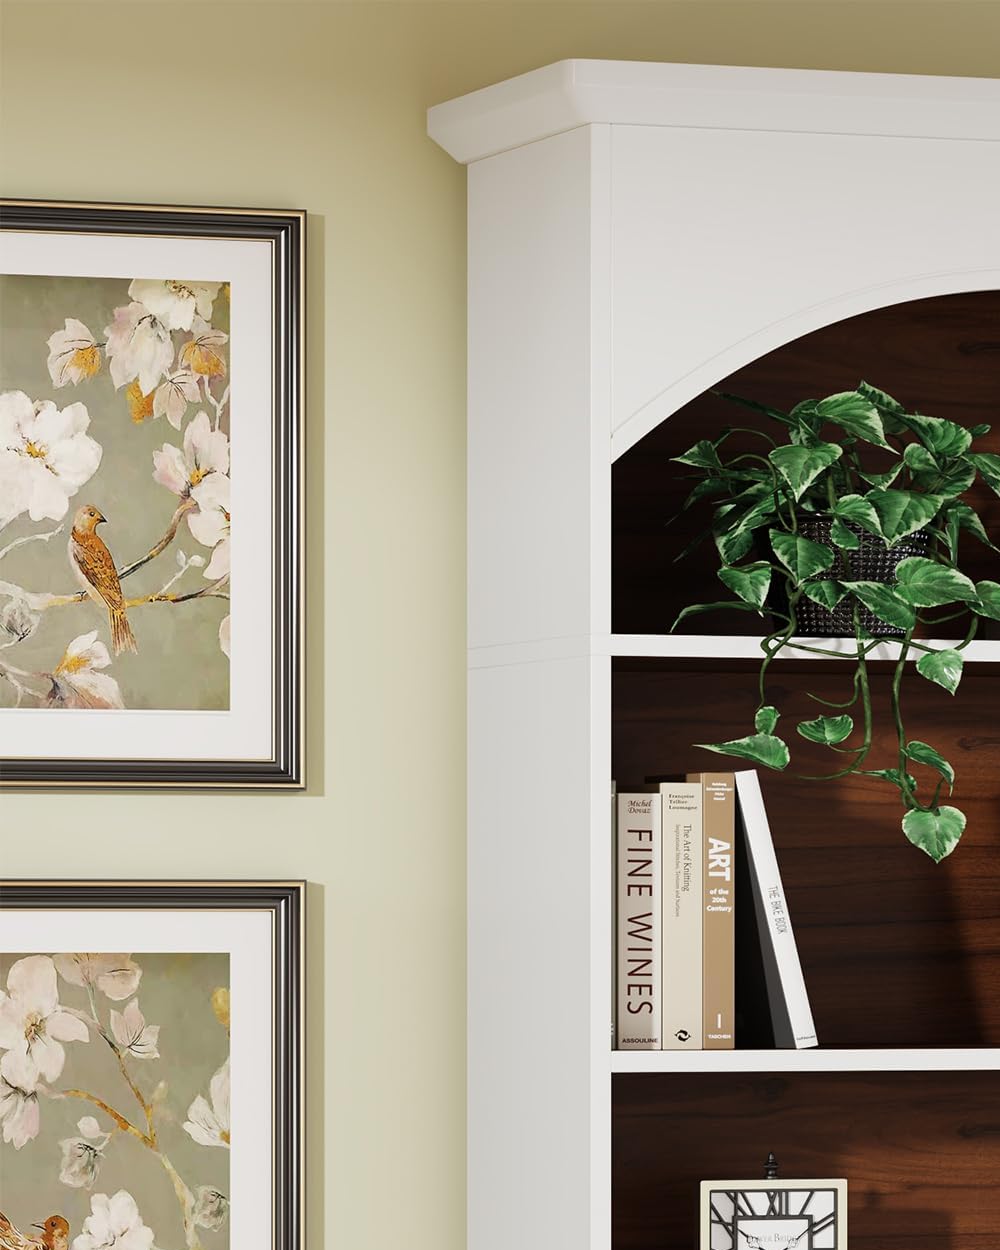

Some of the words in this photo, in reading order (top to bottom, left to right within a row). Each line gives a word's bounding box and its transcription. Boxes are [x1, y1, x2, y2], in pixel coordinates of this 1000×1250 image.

[627, 799, 653, 808] Michel
[627, 806, 652, 814] Dovaz
[683, 824, 692, 838] The
[683, 840, 692, 852] Art
[627, 828, 653, 897] FINE
[683, 853, 692, 861] of
[708, 836, 730, 882] ART
[681, 862, 692, 892] Knitting
[767, 885, 779, 900] THE
[769, 900, 784, 916] BIKE
[773, 916, 789, 935] BOOK
[627, 913, 653, 1015] WINES
